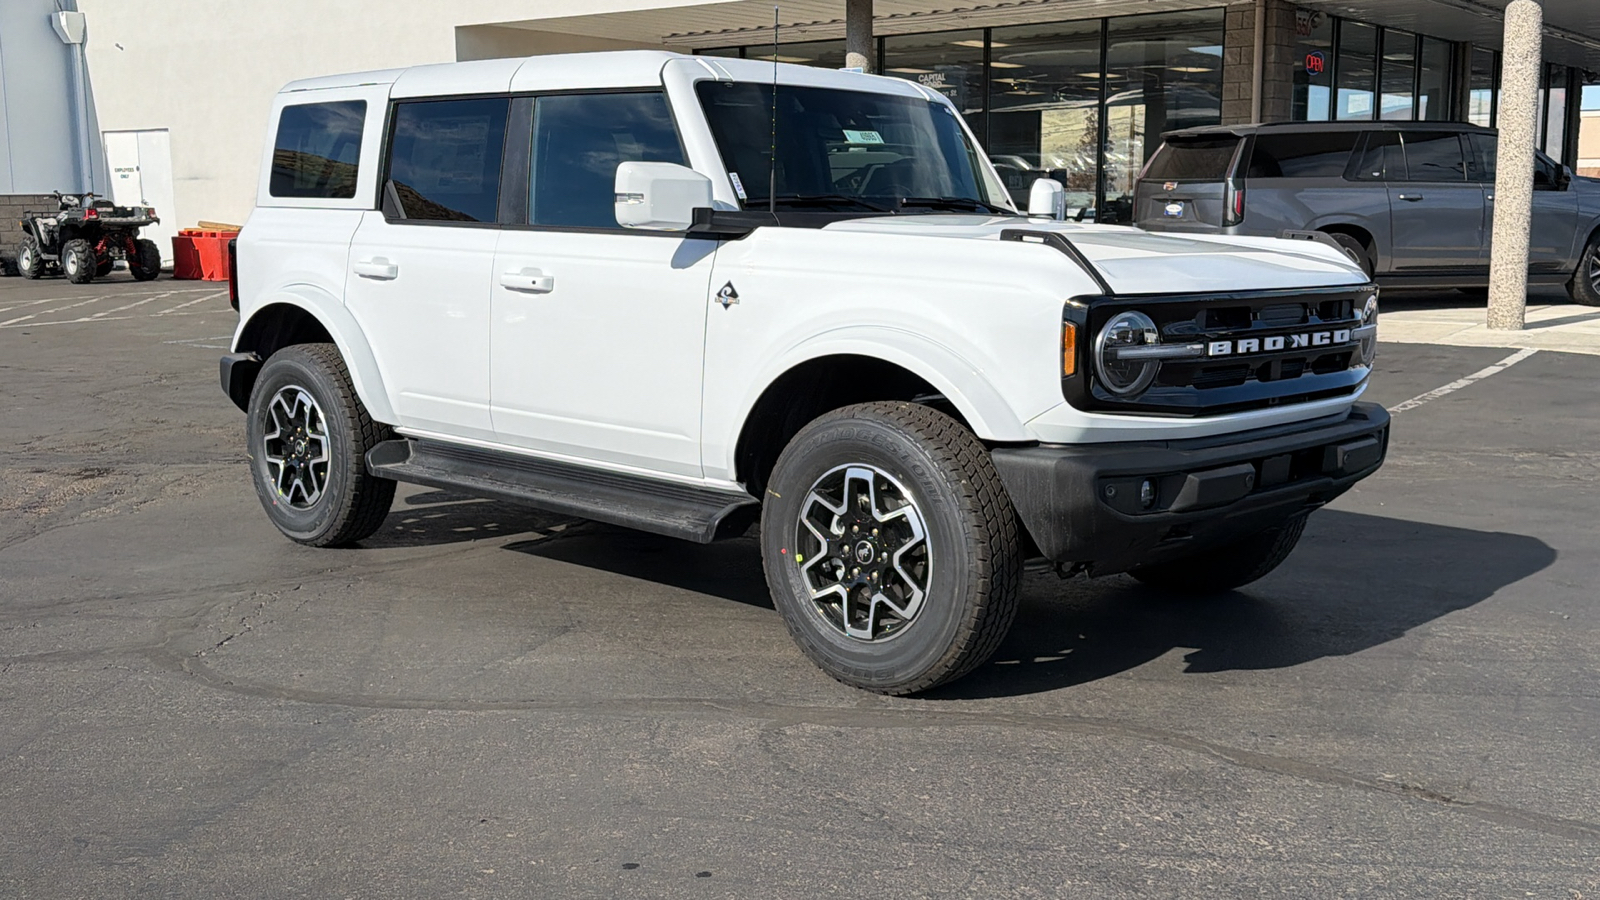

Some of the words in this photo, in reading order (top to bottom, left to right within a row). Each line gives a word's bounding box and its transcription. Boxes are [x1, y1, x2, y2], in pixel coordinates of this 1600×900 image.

[1306, 54, 1324, 72] OPEN
[918, 73, 946, 83] CAPITAL
[1208, 329, 1350, 356] BRONCO
